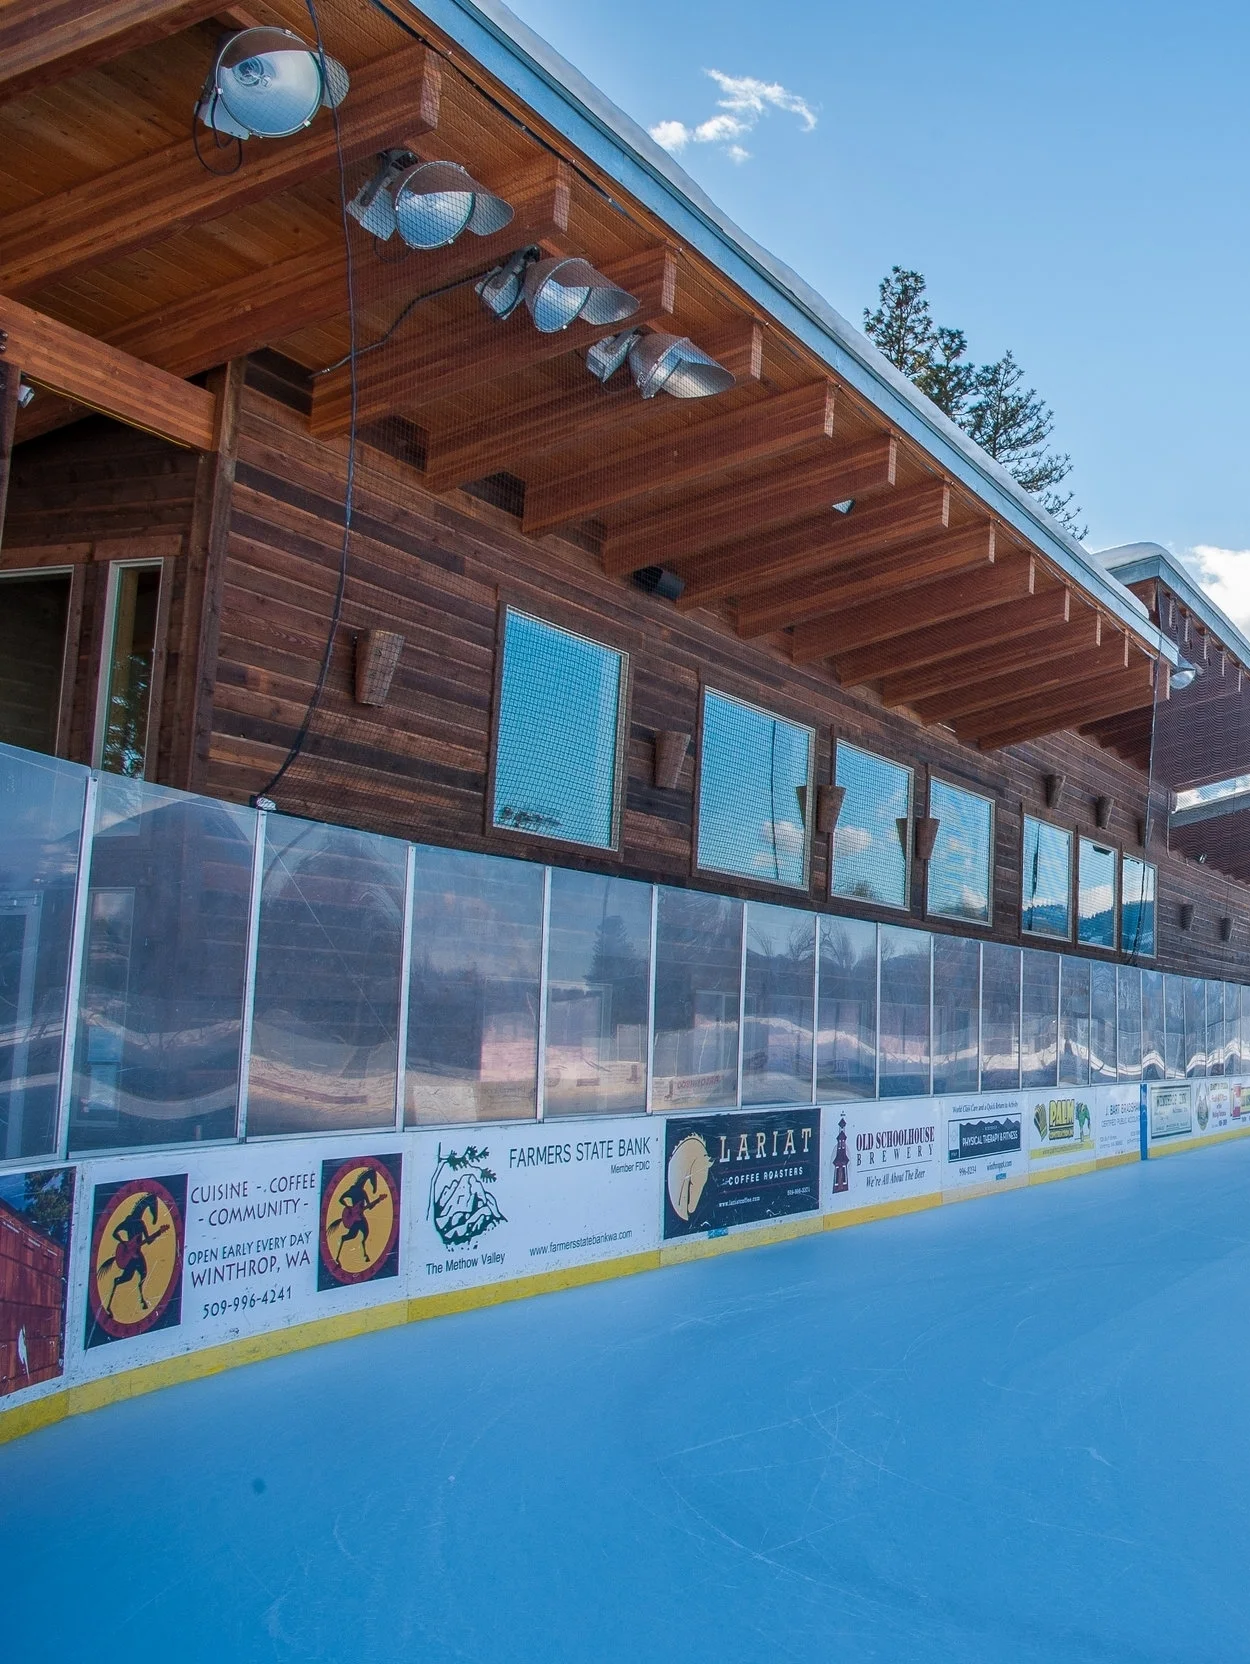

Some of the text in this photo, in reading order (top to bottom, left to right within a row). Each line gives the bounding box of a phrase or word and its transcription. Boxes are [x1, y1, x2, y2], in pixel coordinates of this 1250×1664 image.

[1049, 1099, 1075, 1126] PALM
[509, 1136, 651, 1169] FARMERS STATE BANK
[720, 1128, 812, 1163] LARIAT
[856, 1126, 935, 1152] OLD SCHOOLHOUSE
[962, 1135, 982, 1147] PHYSICAL
[610, 1161, 650, 1174] Member FDIC
[857, 1144, 933, 1166] BREWERY
[191, 1181, 248, 1204] CUISINE
[270, 1173, 316, 1194] COFFEE
[728, 1167, 803, 1186] COFFEE ROASTERS
[866, 1175, 881, 1187] We're
[891, 1172, 904, 1183] About
[905, 1170, 913, 1181] The
[914, 1169, 925, 1179] Beer
[208, 1198, 301, 1226] COMMUNITY
[188, 1231, 313, 1266] OPEN EARLY EVERY DAY
[529, 1228, 633, 1257] www.farmersstatebankwa.com
[191, 1249, 310, 1289] WINTHROP, WA
[426, 1252, 506, 1275] The Methow Valley
[203, 1285, 292, 1319] 509-996-4241
